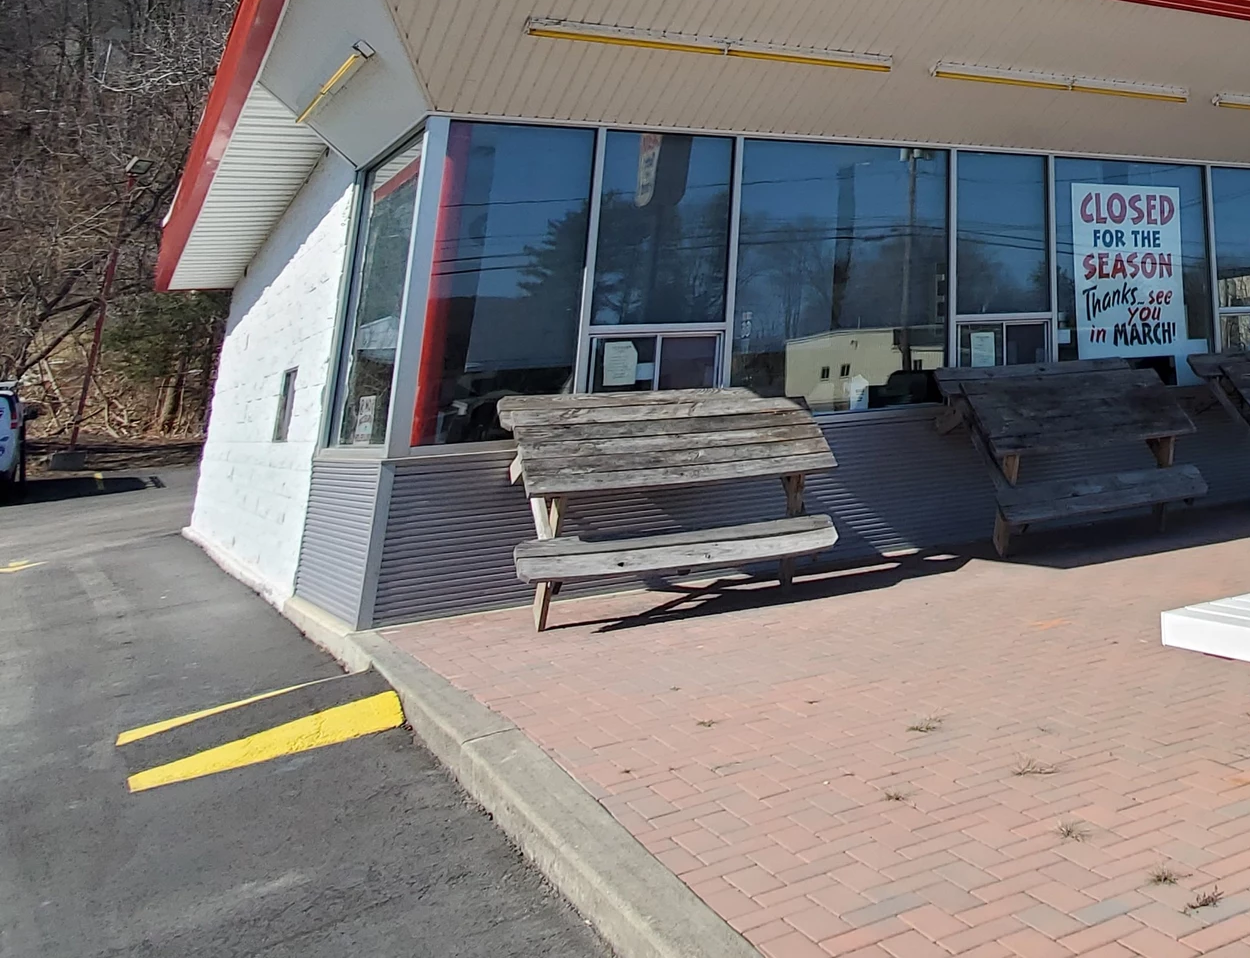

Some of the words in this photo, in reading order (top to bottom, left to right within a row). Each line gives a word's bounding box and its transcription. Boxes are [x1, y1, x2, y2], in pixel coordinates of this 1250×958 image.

[1080, 192, 1175, 225] CLOSED
[1093, 229, 1126, 248] FOR
[1131, 230, 1161, 248] THE
[1082, 252, 1173, 279] SEASON
[1148, 290, 1173, 305] see
[1127, 306, 1161, 326] you
[1090, 325, 1107, 344] in
[1113, 321, 1176, 347] MARCH!
